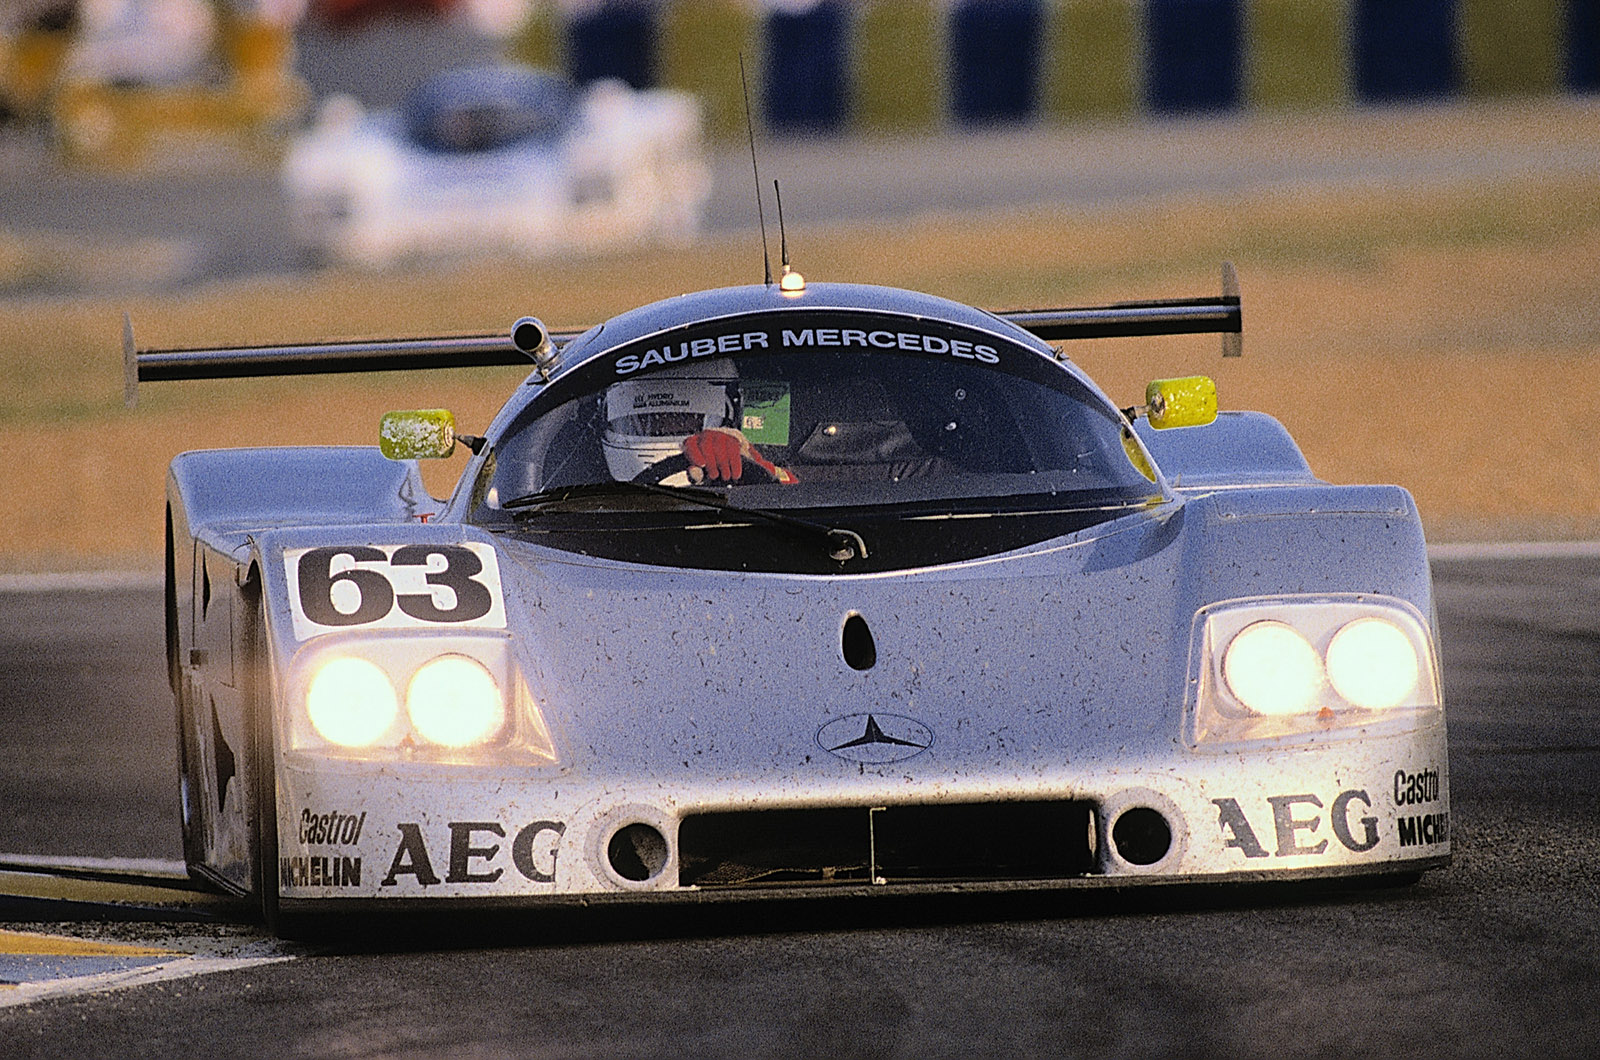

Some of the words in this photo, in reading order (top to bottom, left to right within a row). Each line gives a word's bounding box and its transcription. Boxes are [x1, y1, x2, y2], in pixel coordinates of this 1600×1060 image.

[615, 331, 769, 374] SAUBER
[781, 329, 1000, 364] MERCEDES
[297, 543, 493, 627] 63
[299, 807, 367, 846] Castrol
[381, 820, 568, 887] AEG
[1211, 789, 1381, 858] AEG
